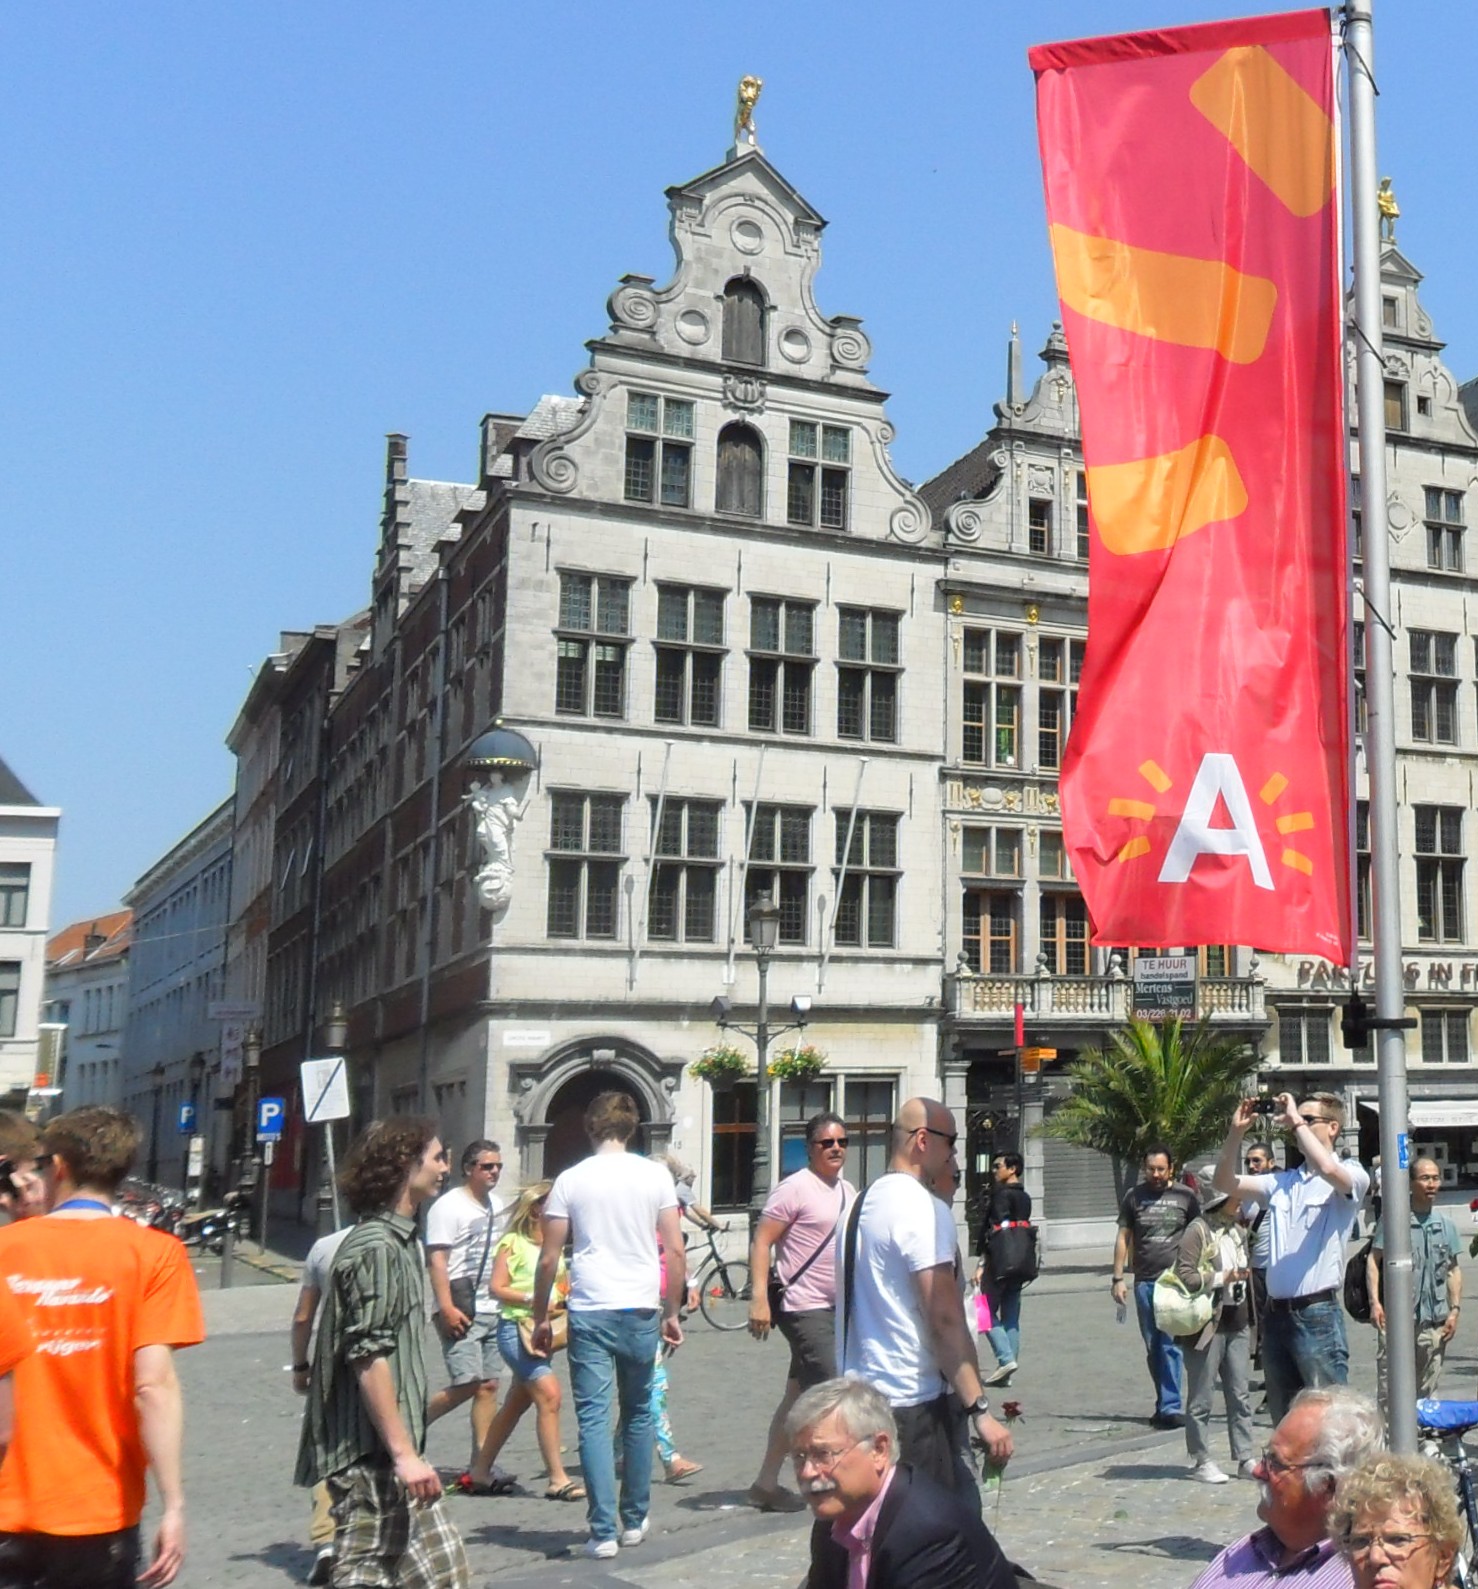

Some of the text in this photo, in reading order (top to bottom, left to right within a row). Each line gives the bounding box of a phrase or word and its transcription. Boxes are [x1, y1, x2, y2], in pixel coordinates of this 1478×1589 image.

[1157, 752, 1275, 891] A
[1143, 959, 1187, 970] TE HUUR
[1429, 962, 1453, 981] IN
[1135, 983, 1173, 993] Mertens
[1156, 992, 1193, 1007] Vastgoed
[181, 1106, 194, 1123] P
[261, 1103, 280, 1127] P
